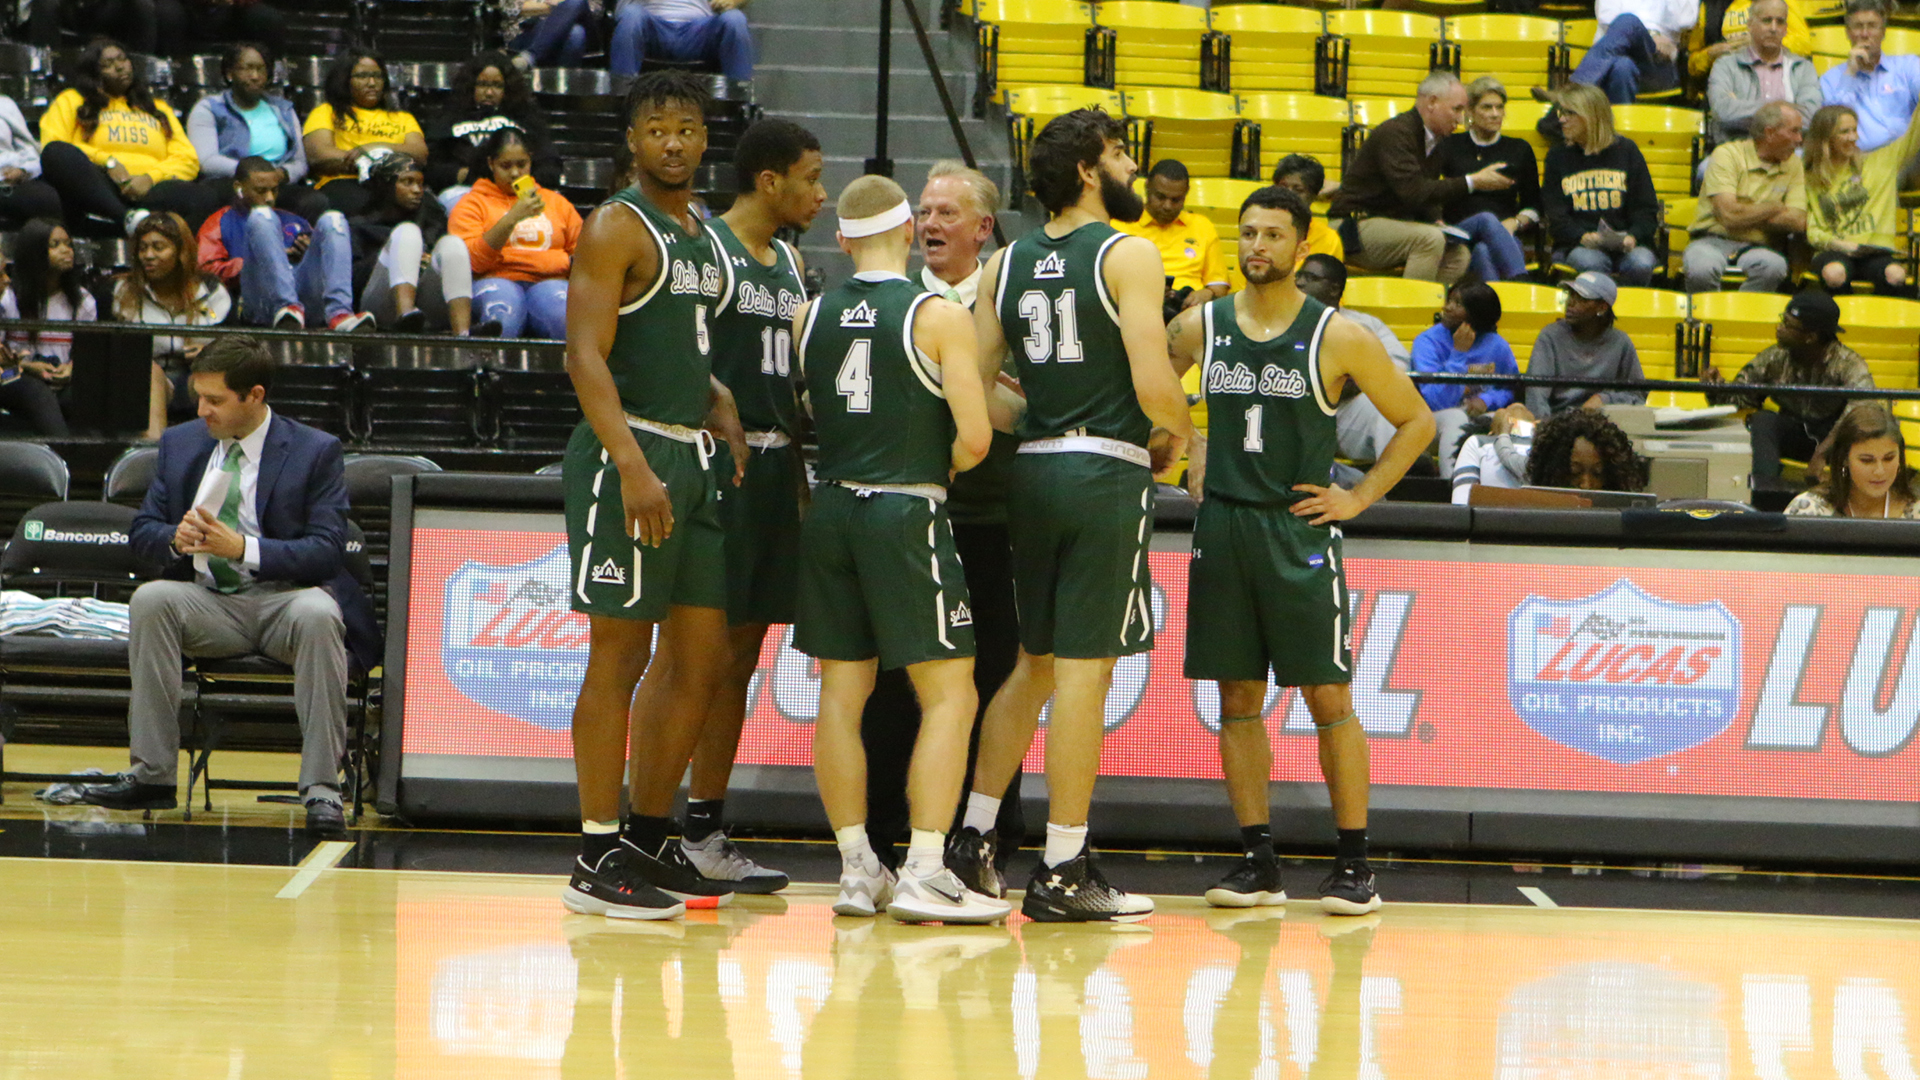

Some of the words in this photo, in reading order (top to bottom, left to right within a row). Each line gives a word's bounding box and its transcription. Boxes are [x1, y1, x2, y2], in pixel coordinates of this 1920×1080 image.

[108, 125, 149, 145] MISS
[1572, 189, 1622, 211] MISS
[700, 262, 719, 298] Sta
[737, 280, 776, 318] Delta
[777, 288, 802, 322] Sta
[695, 303, 711, 355] 5
[1018, 288, 1084, 364] 31
[761, 325, 791, 377] 10
[835, 338, 873, 413] 4
[1209, 361, 1256, 394] Delta
[1258, 363, 1307, 398] State
[1244, 404, 1264, 453] 1
[43, 529, 130, 545] BancorpSo
[469, 606, 592, 650] LUC
[455, 658, 500, 679] OIL
[510, 660, 586, 682] PROD
[1535, 641, 1722, 686] LUCAS
[1521, 693, 1566, 713] OIL
[1577, 695, 1723, 717] PRODUCTS
[1599, 723, 1645, 743] INC
